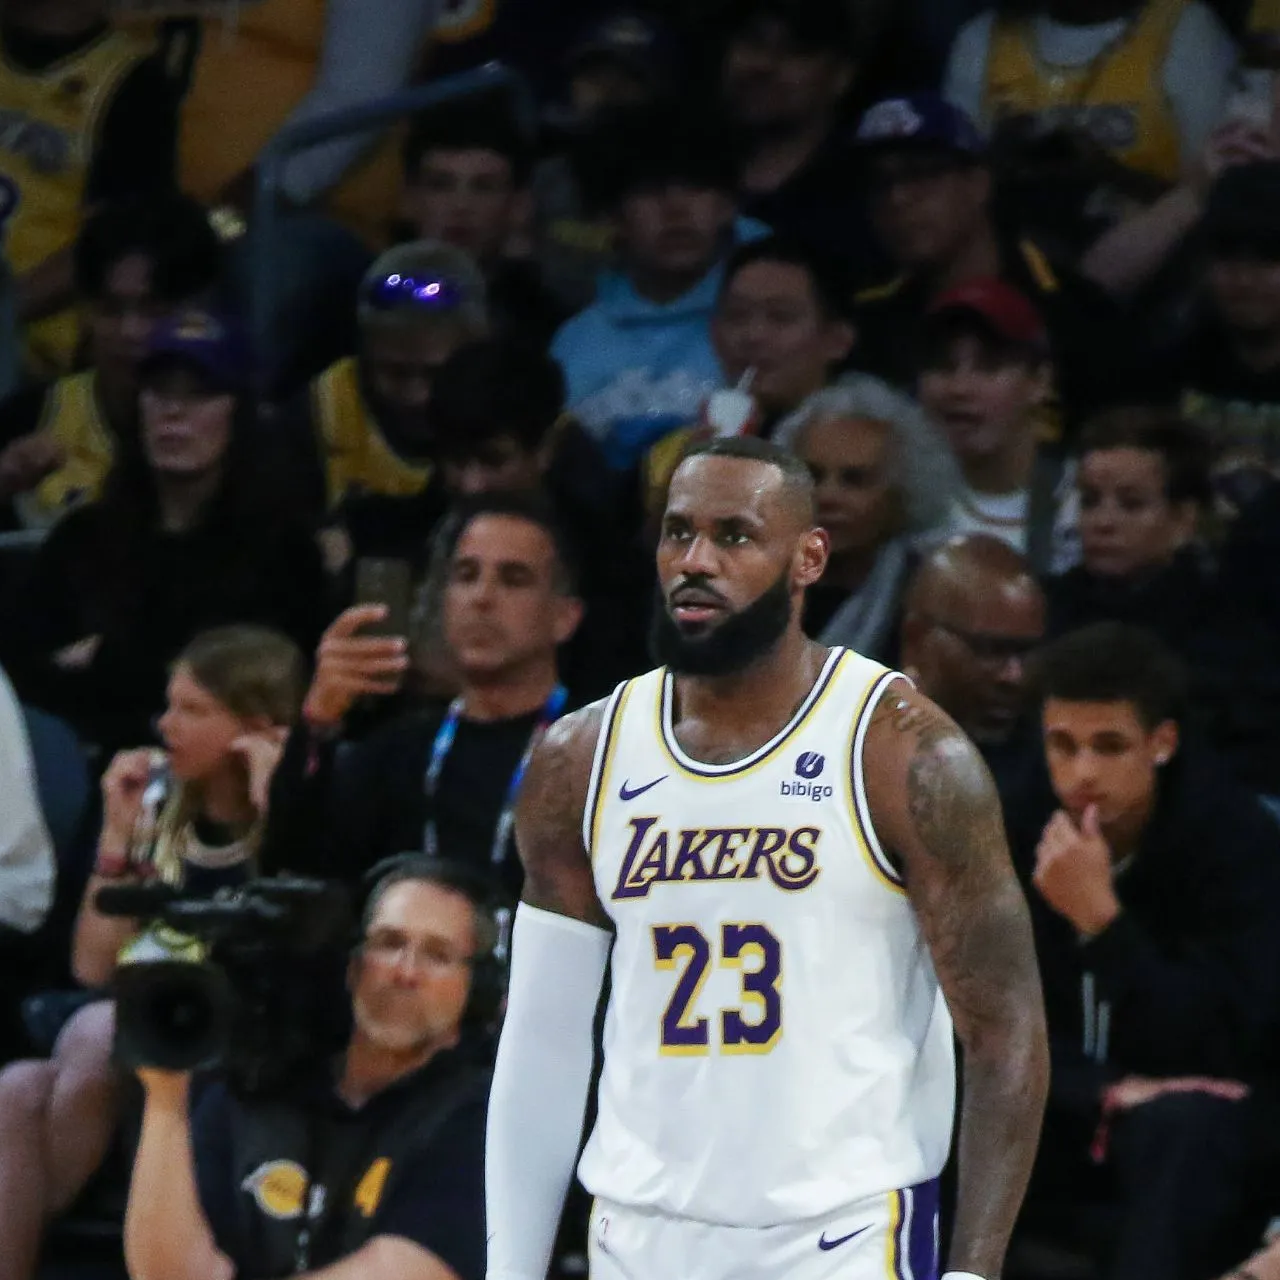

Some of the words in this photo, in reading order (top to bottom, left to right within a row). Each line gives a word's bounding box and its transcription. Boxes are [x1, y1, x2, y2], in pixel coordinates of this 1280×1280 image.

[780, 780, 833, 802] bibigo
[610, 816, 823, 902] LAKERS
[650, 920, 785, 1057] 23
